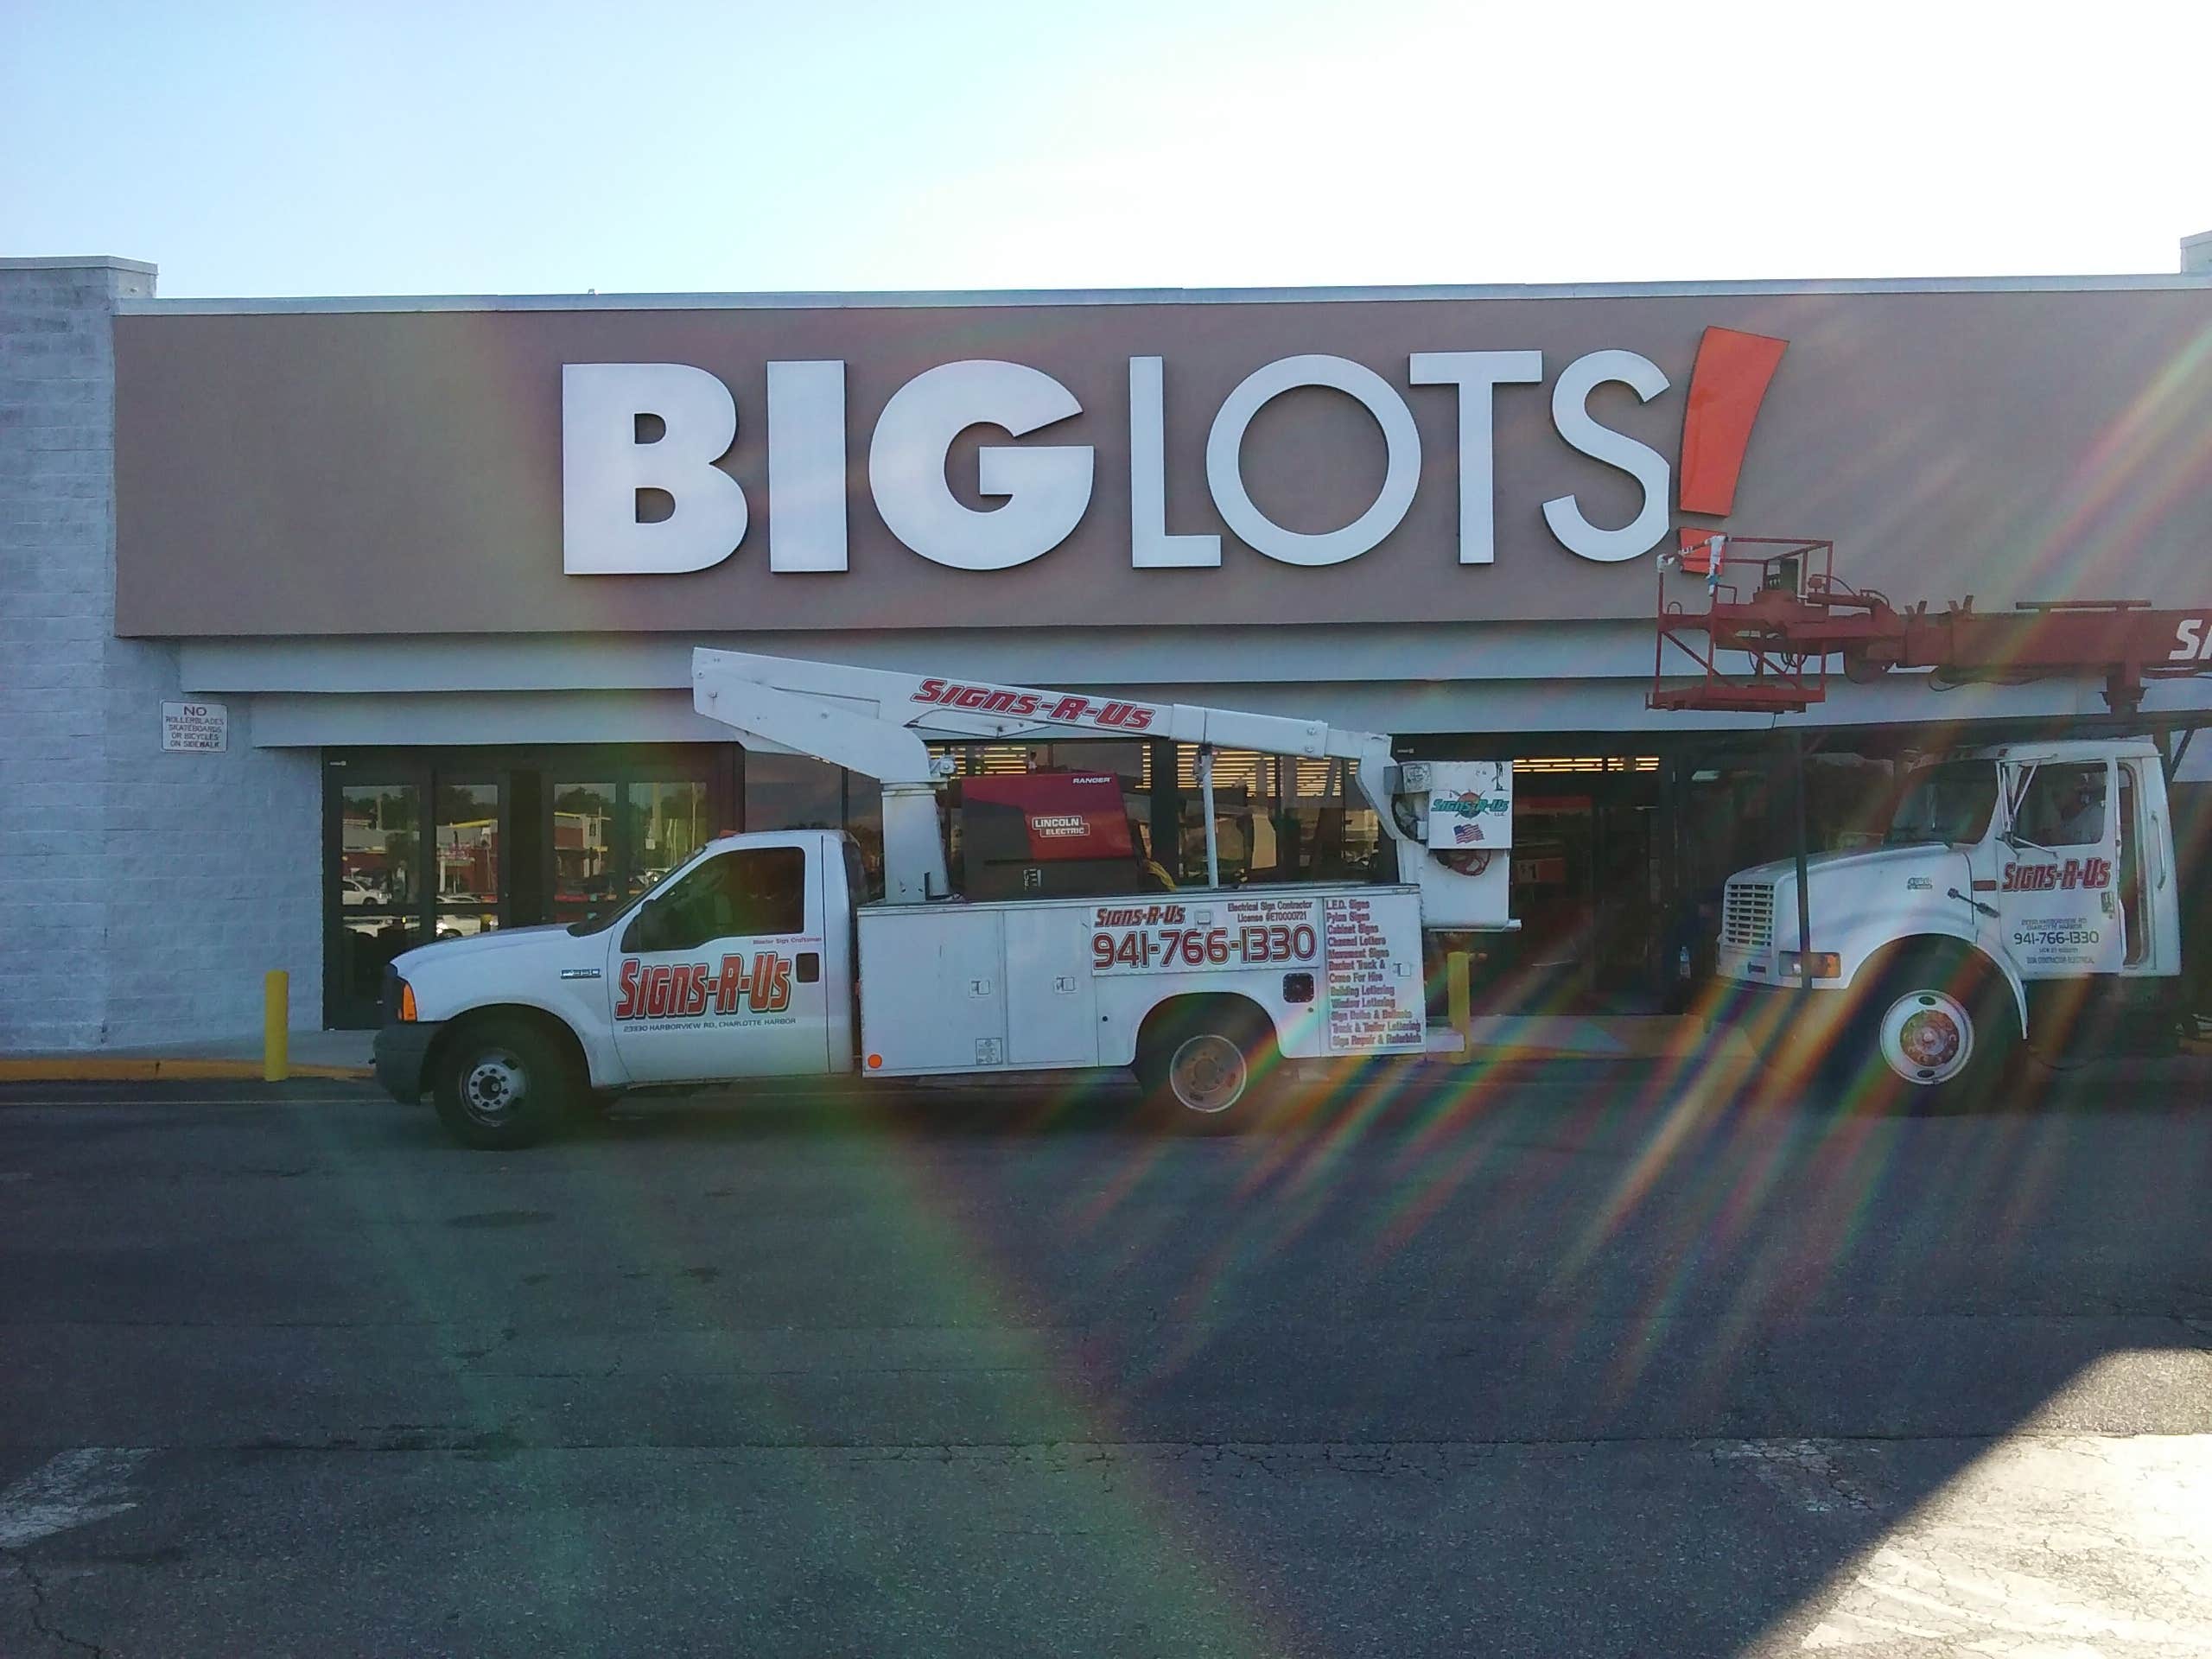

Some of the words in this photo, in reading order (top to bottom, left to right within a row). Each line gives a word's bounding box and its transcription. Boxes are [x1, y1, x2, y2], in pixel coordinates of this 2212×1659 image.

[562, 359, 1096, 576] BIG
[1128, 326, 1789, 575] LOTS!
[183, 705, 207, 716] NO
[165, 716, 224, 726] ROLLERBLADES
[168, 724, 222, 733] SKATEBOARDS
[1034, 817, 1079, 828] LINCOLN
[1046, 827, 1084, 836] ELECTRIC
[1228, 902, 1259, 912] Electrical
[1260, 901, 1275, 912] Sign
[1277, 900, 1313, 910] Contractor
[1349, 899, 1370, 911] Signs
[1237, 913, 1263, 923] License
[1349, 912, 1370, 923] Signs
[2013, 931, 2099, 944] 941-766-1330
[1090, 924, 1318, 970] 941-766-1330
[1379, 959, 1385, 969] &
[649, 1022, 701, 1032] HARBORVIEW
[718, 1020, 762, 1028] CHARLOTTE
